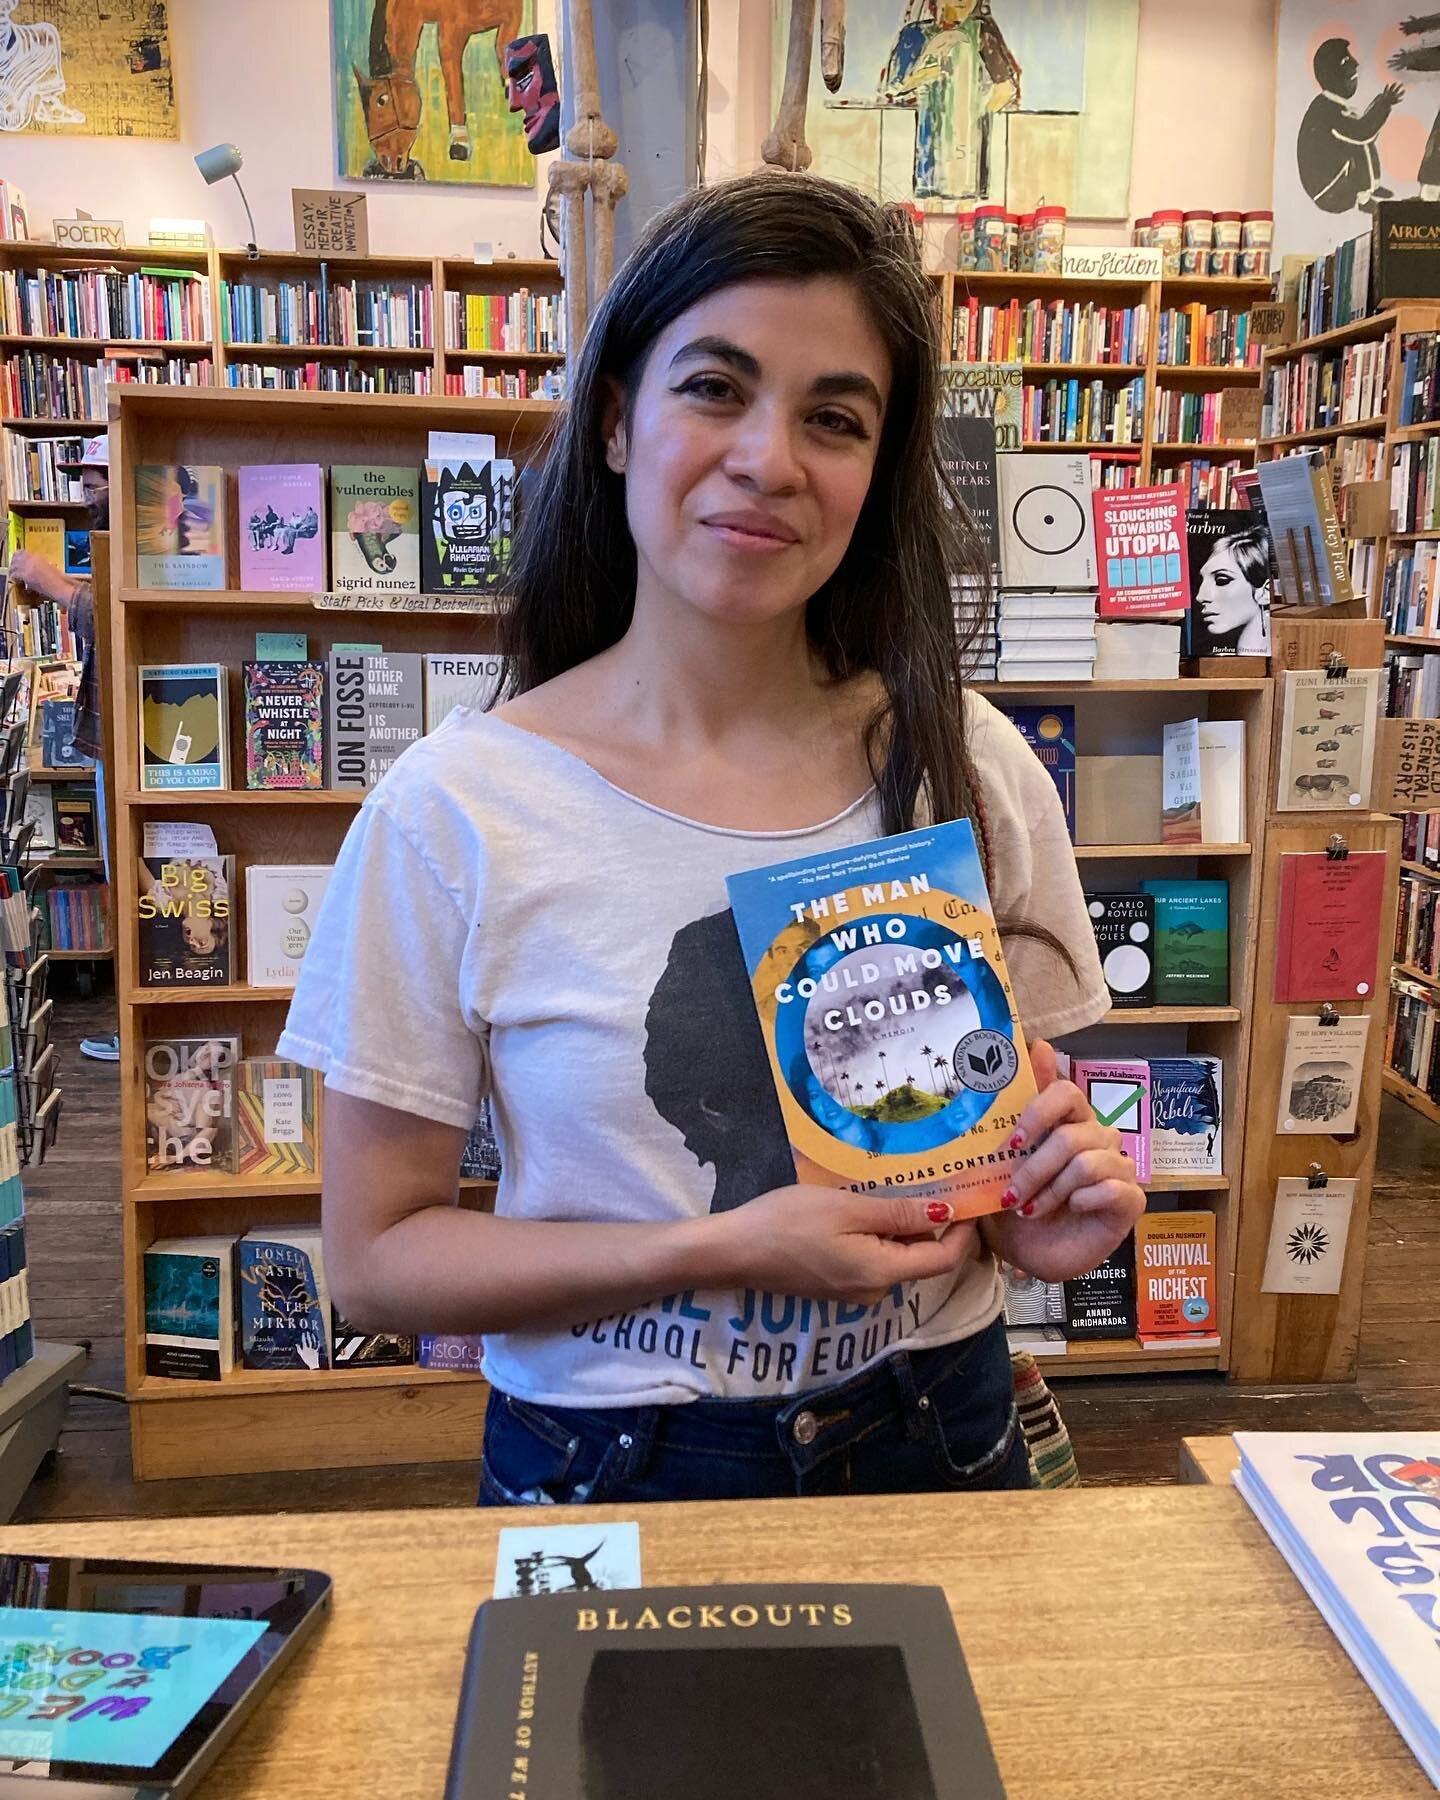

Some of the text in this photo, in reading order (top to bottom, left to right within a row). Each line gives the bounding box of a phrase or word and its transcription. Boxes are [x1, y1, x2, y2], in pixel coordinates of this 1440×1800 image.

[329, 196, 344, 251] CREATIVE
[56, 225, 121, 247] POETRY
[1064, 252, 1160, 277] new fiction
[363, 471, 386, 483] the
[335, 483, 414, 497] vulnerables
[1104, 505, 1178, 523] SLOUCHING
[1109, 519, 1172, 536] TOWARDS
[1105, 531, 1181, 556] UTOPIA
[1324, 514, 1347, 582] They Flew
[450, 554, 491, 562] RHAPSODY
[336, 577, 416, 590] sigrid nunez
[320, 594, 489, 611] Staff Picks & Local Bestsellers
[1212, 646, 1236, 654] Barbra
[367, 657, 389, 670] THE
[430, 660, 500, 677] TREMO
[367, 670, 403, 683] OTHER
[1296, 677, 1368, 687] ZUNI FETISHES
[335, 656, 365, 732] FOSSE
[367, 683, 400, 696] NAME
[265, 695, 303, 706] NEVER
[258, 708, 310, 719] WHISTLE
[368, 714, 387, 727] I IS
[267, 729, 302, 740] NIGHT
[369, 727, 419, 740] ANOTHER
[337, 741, 366, 787] JON
[369, 758, 377, 771] A
[1412, 735, 1435, 803] GENERAL
[147, 769, 171, 777] THIS
[174, 769, 183, 777] IS
[150, 775, 217, 785] DO YOU COPY?
[777, 867, 817, 882] spellbinding
[817, 863, 830, 871] and
[831, 852, 878, 870] genre-defying
[815, 854, 911, 882] New York Times Book Review
[160, 864, 208, 893] Big
[789, 873, 931, 923] THE MAN
[1110, 901, 1144, 909] CARLO
[138, 893, 230, 919] Swiss
[1107, 909, 1148, 918] ROVELLI
[288, 927, 302, 935] Our
[830, 917, 907, 951] WHO
[1093, 924, 1125, 933] WHITE
[148, 966, 223, 981] Jen Beagin
[266, 967, 295, 977] Lydia
[774, 938, 986, 1004] COULD MOVE
[824, 984, 953, 1032] CLOUDS
[880, 1026, 916, 1040] MEMOIR
[956, 1032, 1015, 1078] NATIONAL BOOK AWARD
[1081, 1069, 1108, 1078] Travis
[1109, 1071, 1147, 1080] Alabanza
[972, 1075, 1009, 1090] FINALIST
[1151, 1080, 1205, 1102] Magnificent
[1151, 1095, 1194, 1129] Rebels
[272, 1127, 295, 1136] Briggs
[1152, 1157, 1217, 1165] ANDREA WULF
[885, 1167, 936, 1187] ROJAS
[939, 1185, 953, 1193] THE
[255, 1247, 307, 1265] LONELY
[1143, 1244, 1211, 1268] SURVIVAL
[255, 1265, 310, 1282] CASTLE
[1148, 1277, 1208, 1301] RICHEST
[261, 1301, 310, 1314] IN THE
[1086, 1309, 1112, 1317] ANAND
[252, 1317, 320, 1331] MIRROR
[1072, 1317, 1127, 1328] GIRIDHARADAS
[421, 1340, 481, 1363] History
[726, 1337, 798, 1383] FOR
[576, 1603, 854, 1632] BLACKOUTS
[510, 1650, 540, 1785] AUTHOR OF WE
